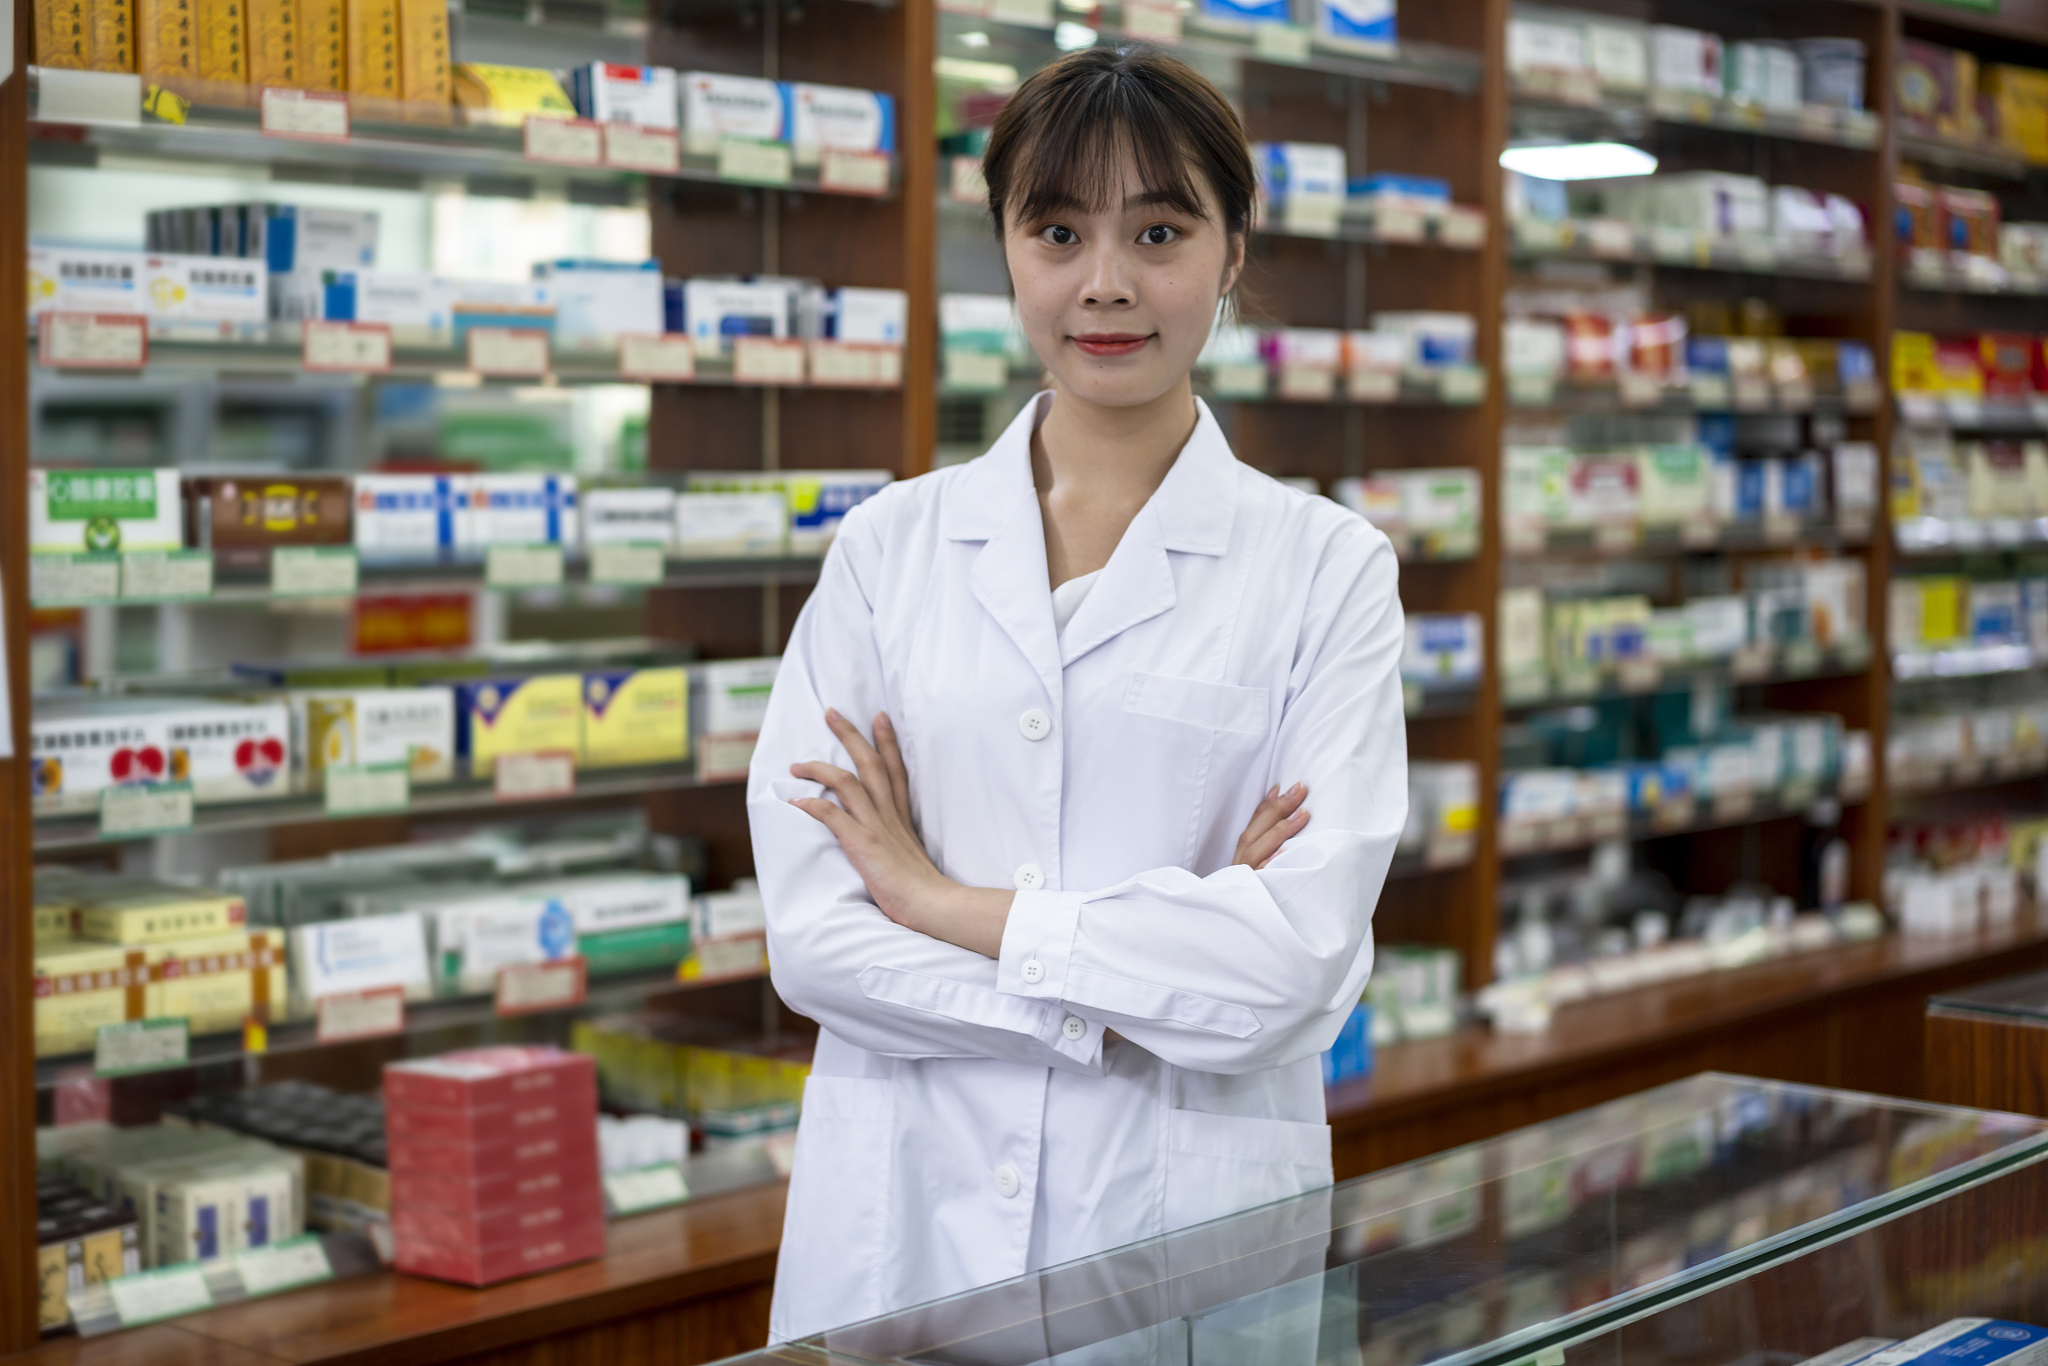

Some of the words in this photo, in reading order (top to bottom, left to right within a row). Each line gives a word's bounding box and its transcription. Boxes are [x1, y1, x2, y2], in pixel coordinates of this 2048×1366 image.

[49, 475, 154, 502] 心脑康胶囊
